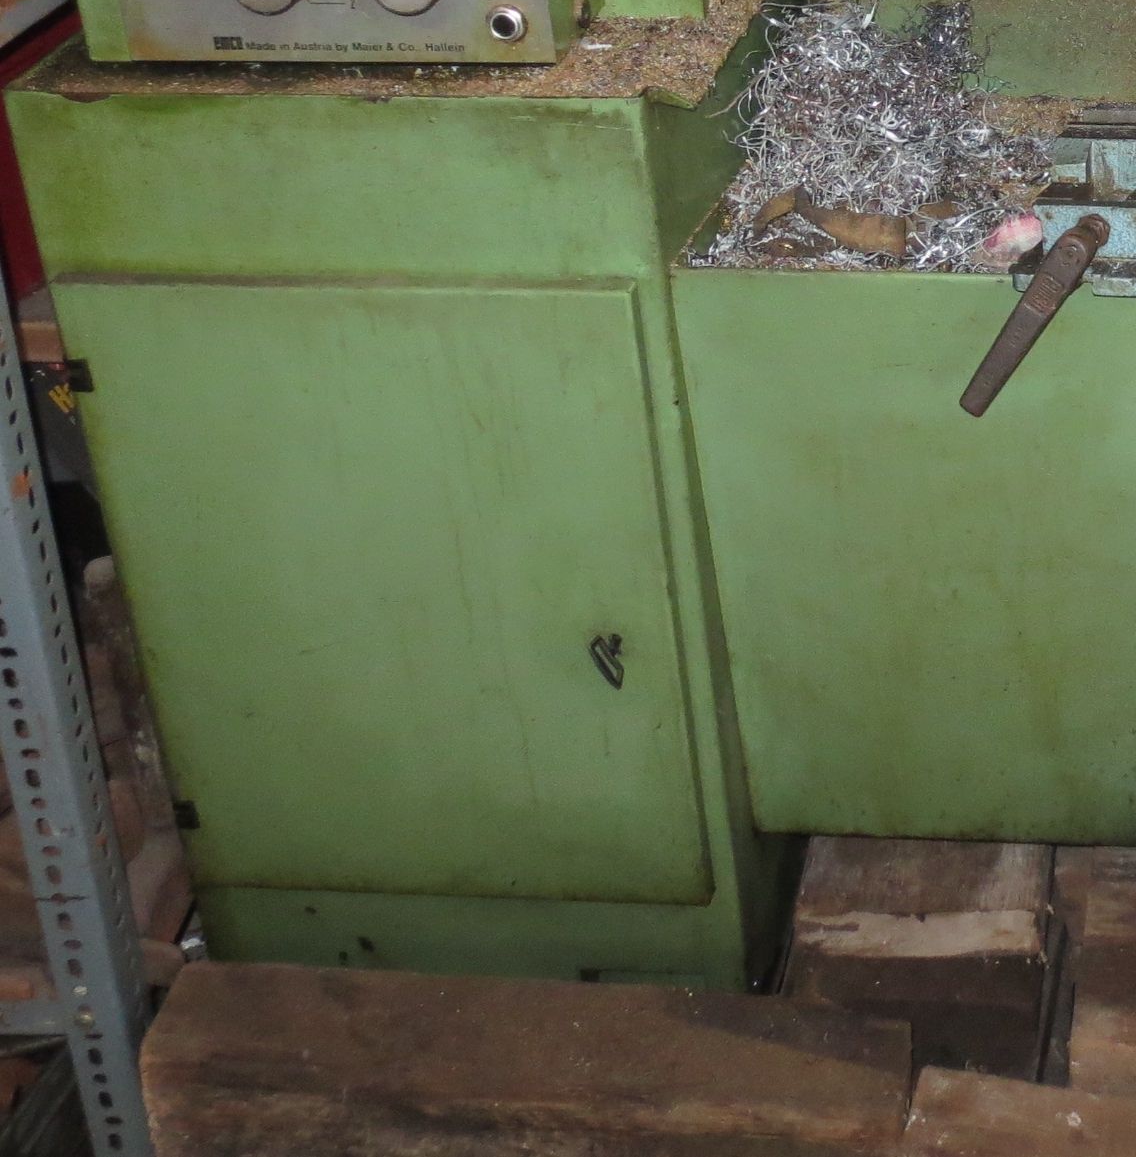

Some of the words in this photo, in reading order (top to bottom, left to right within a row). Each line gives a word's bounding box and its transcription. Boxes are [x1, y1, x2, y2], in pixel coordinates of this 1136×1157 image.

[335, 42, 348, 53] by
[386, 42, 394, 51] &
[425, 42, 465, 53] Hallein
